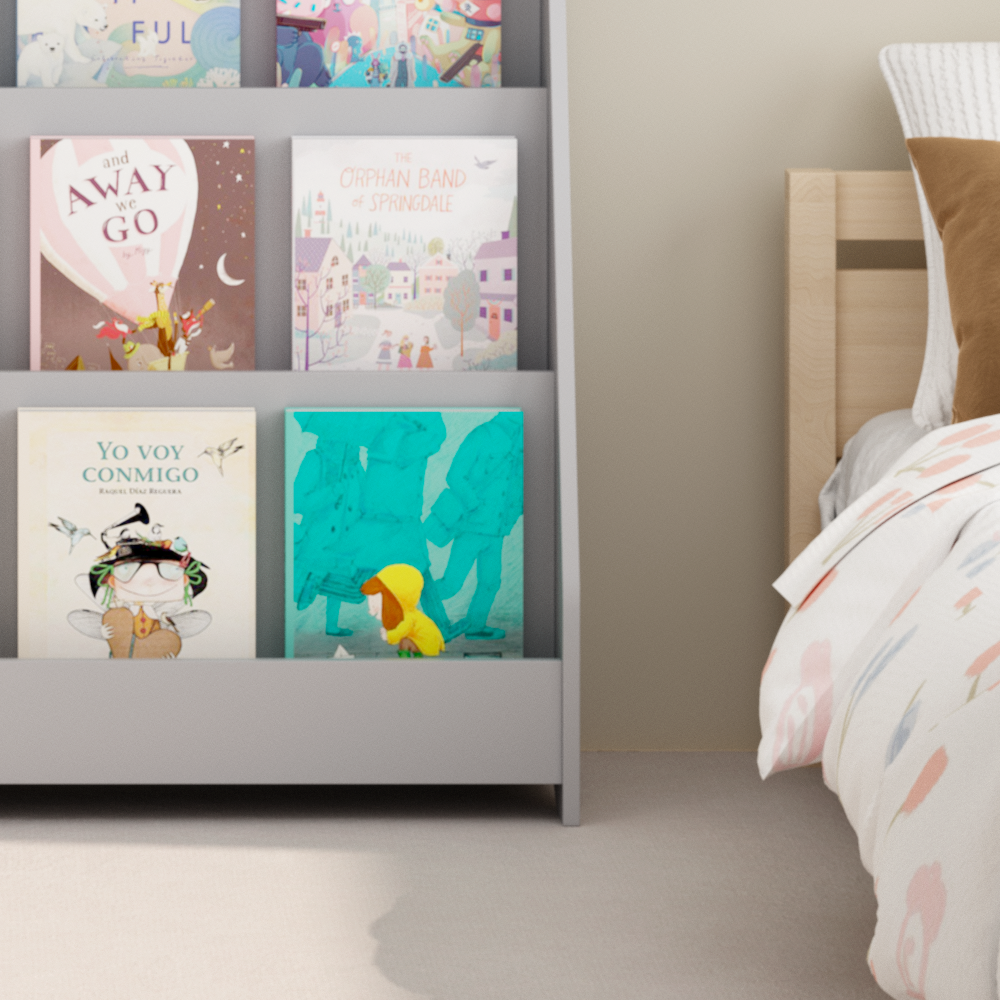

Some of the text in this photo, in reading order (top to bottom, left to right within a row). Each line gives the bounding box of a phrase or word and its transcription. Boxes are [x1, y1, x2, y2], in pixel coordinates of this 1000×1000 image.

[132, 21, 191, 44] FUL
[103, 150, 129, 168] and
[395, 152, 412, 163] THE
[340, 166, 467, 189] ORPHAN BAND
[68, 164, 175, 216] AWAY
[115, 199, 137, 212] we
[352, 193, 454, 212] of SPRINGDALE
[102, 208, 159, 243] GO
